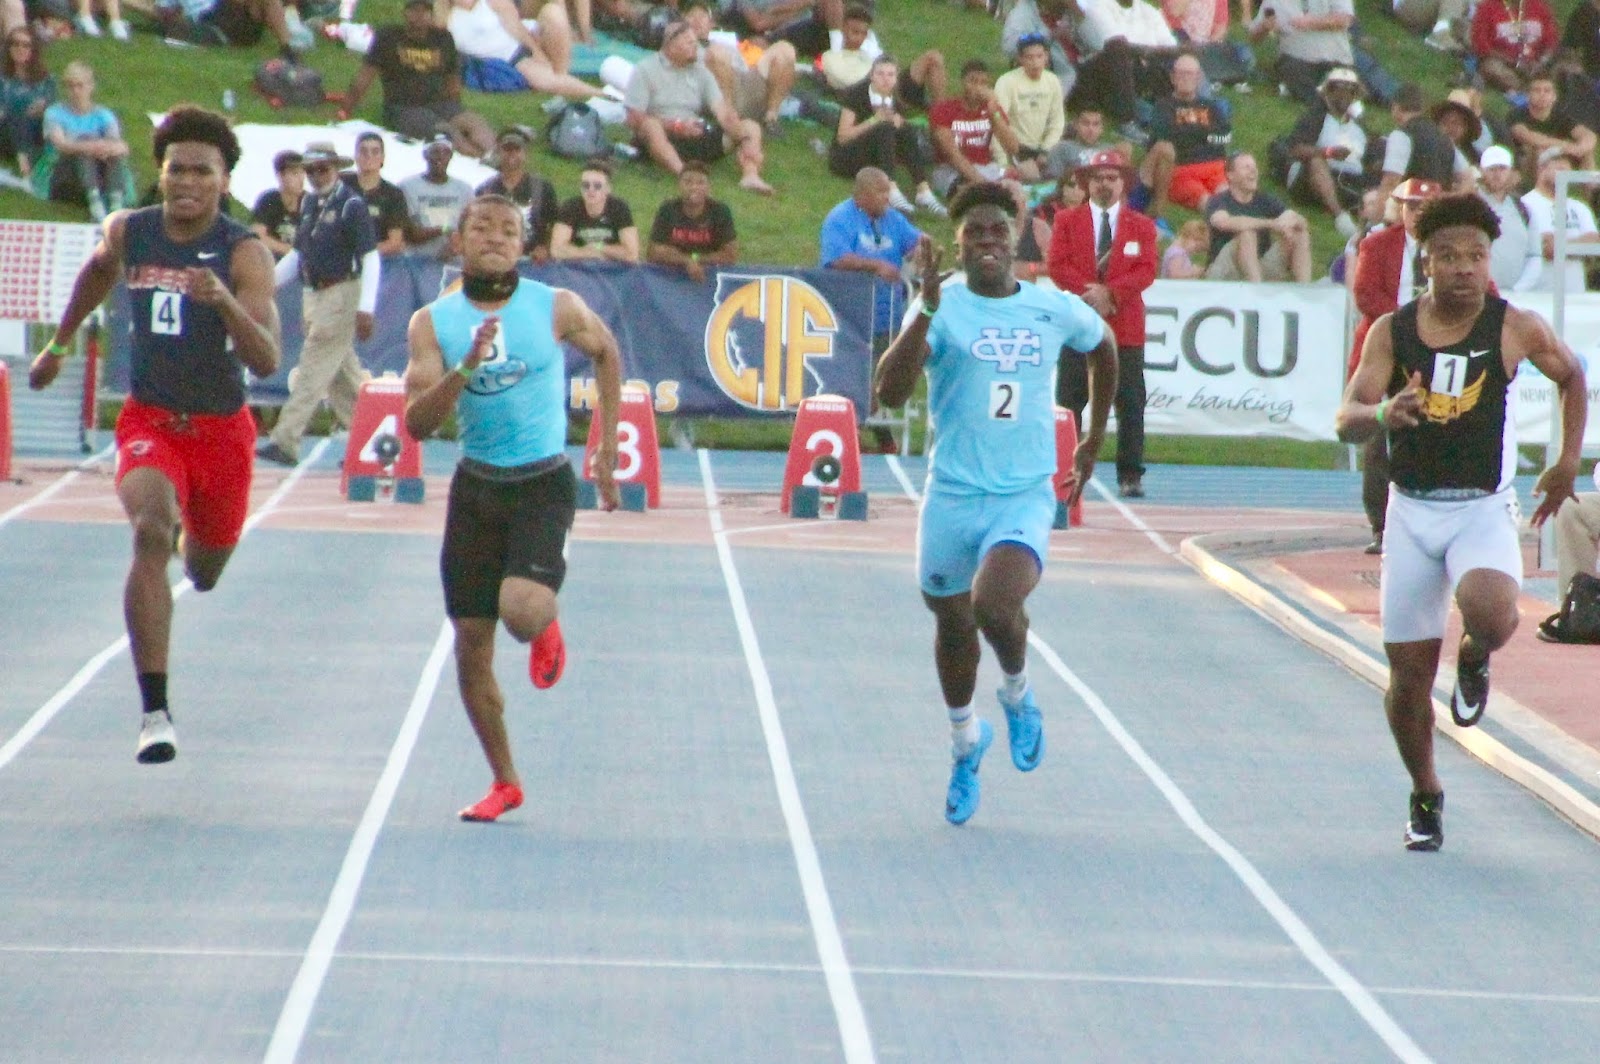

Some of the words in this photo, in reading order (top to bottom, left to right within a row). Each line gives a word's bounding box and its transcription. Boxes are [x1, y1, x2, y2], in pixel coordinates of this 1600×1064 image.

[158, 295, 175, 332] 4
[704, 272, 839, 412] CIF
[1444, 358, 1457, 393] 1
[995, 384, 1013, 418] 2
[1187, 386, 1295, 423] banking
[802, 428, 843, 488] 2
